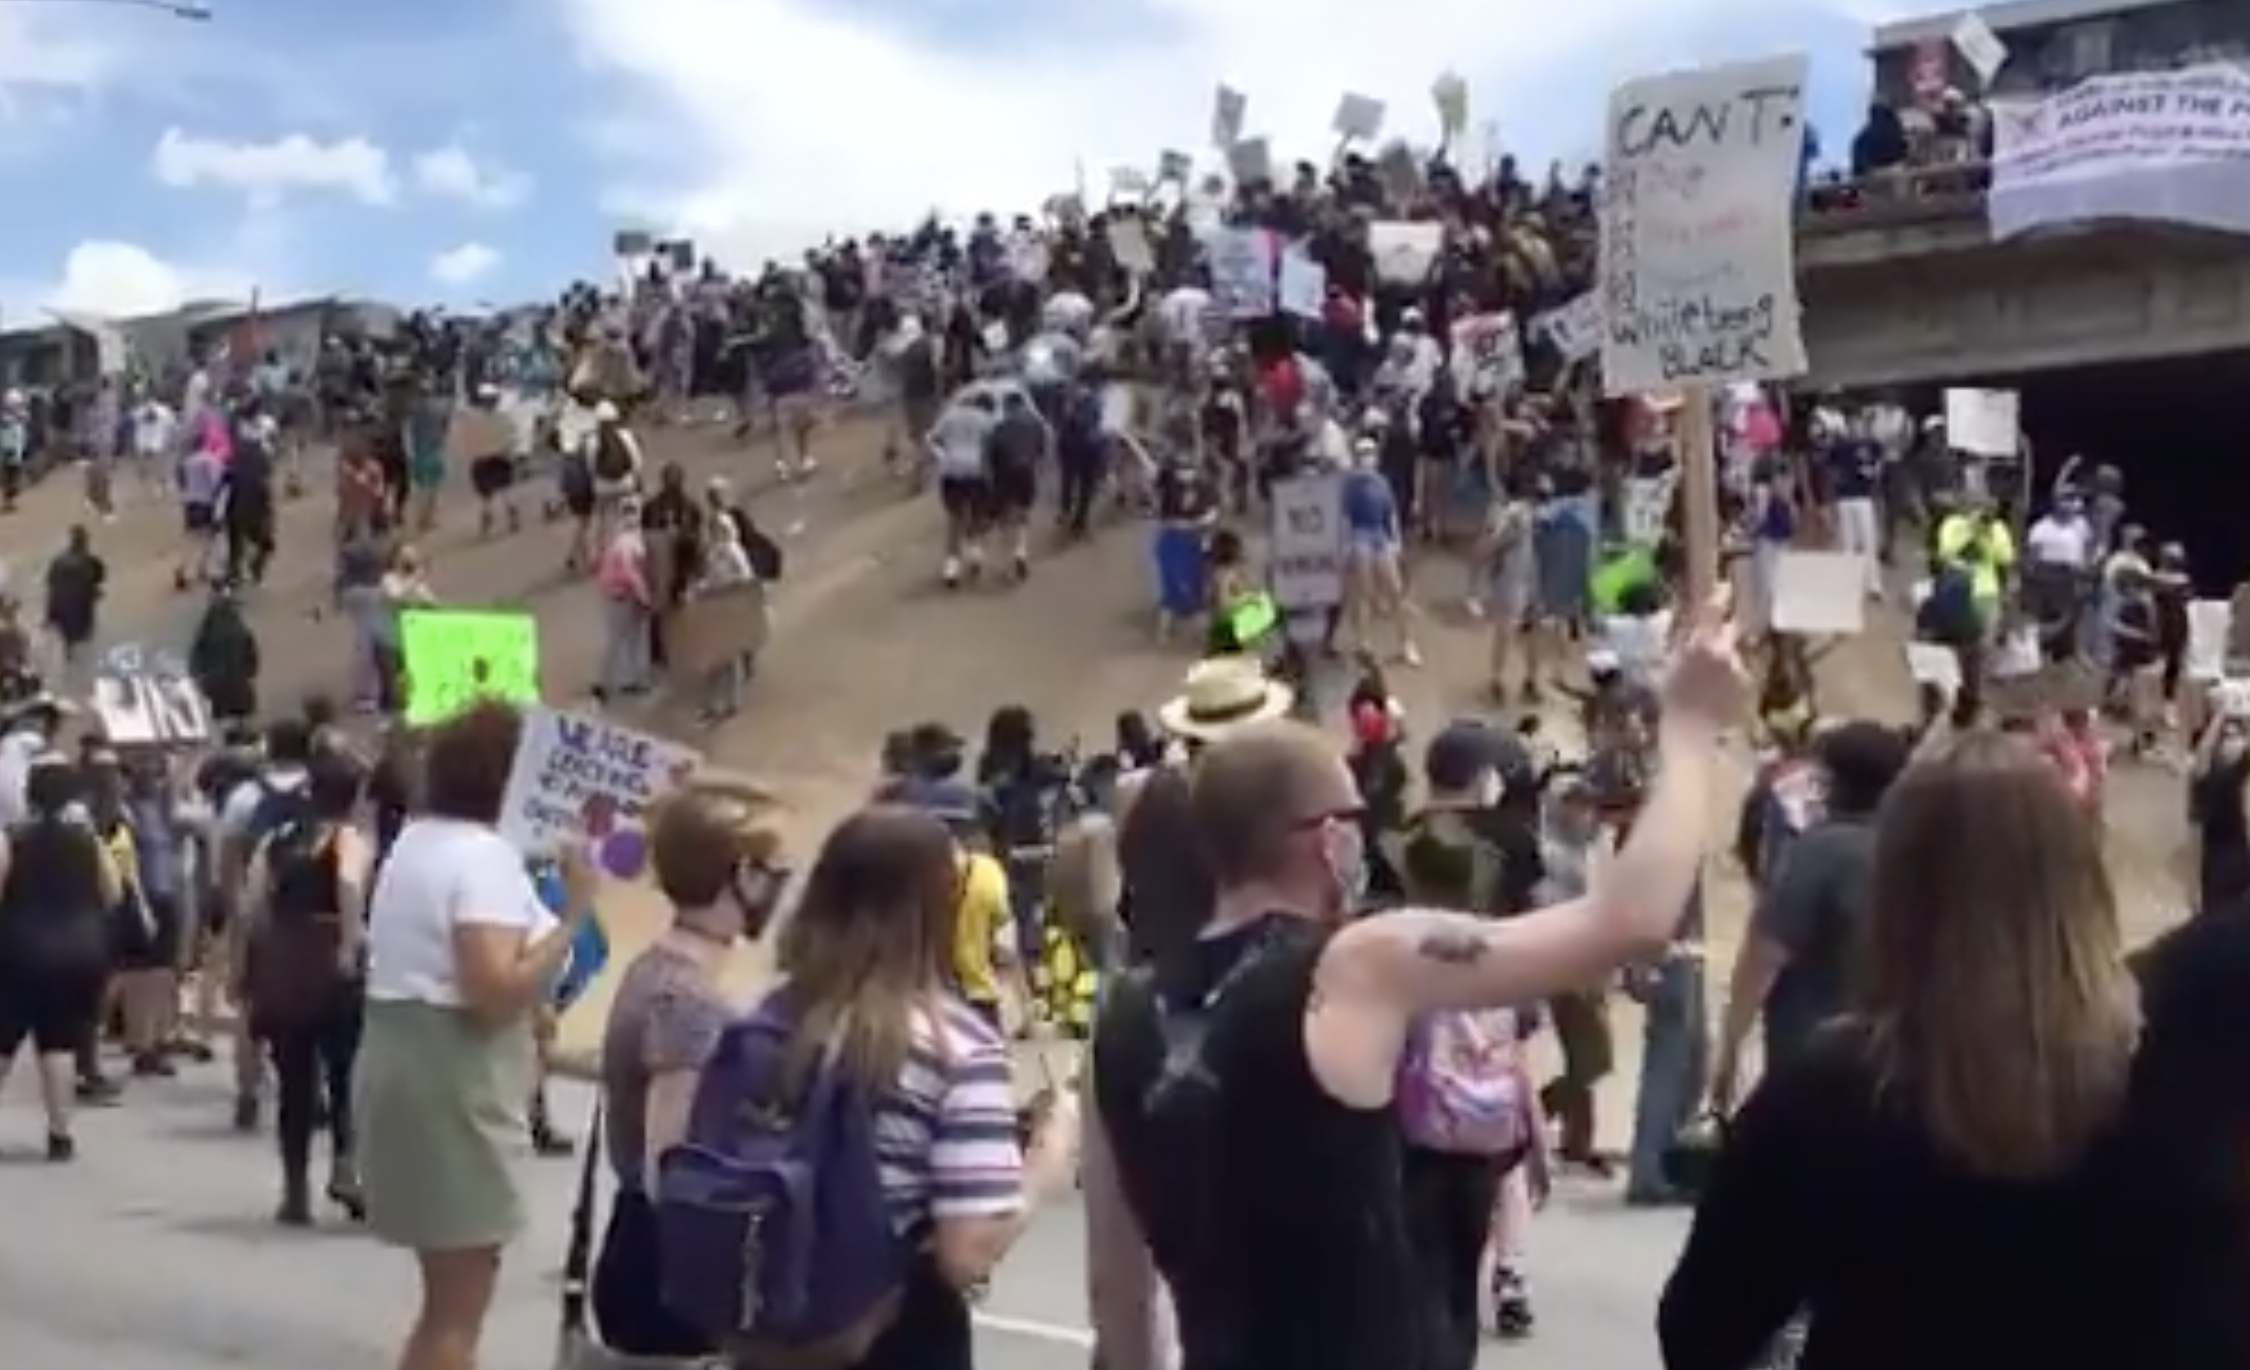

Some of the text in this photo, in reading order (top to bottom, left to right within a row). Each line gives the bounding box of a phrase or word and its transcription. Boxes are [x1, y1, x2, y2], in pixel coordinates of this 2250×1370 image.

[2059, 94, 2168, 127] AGAINST
[2176, 93, 2220, 117] THE
[1658, 335, 1769, 380] BLACK
